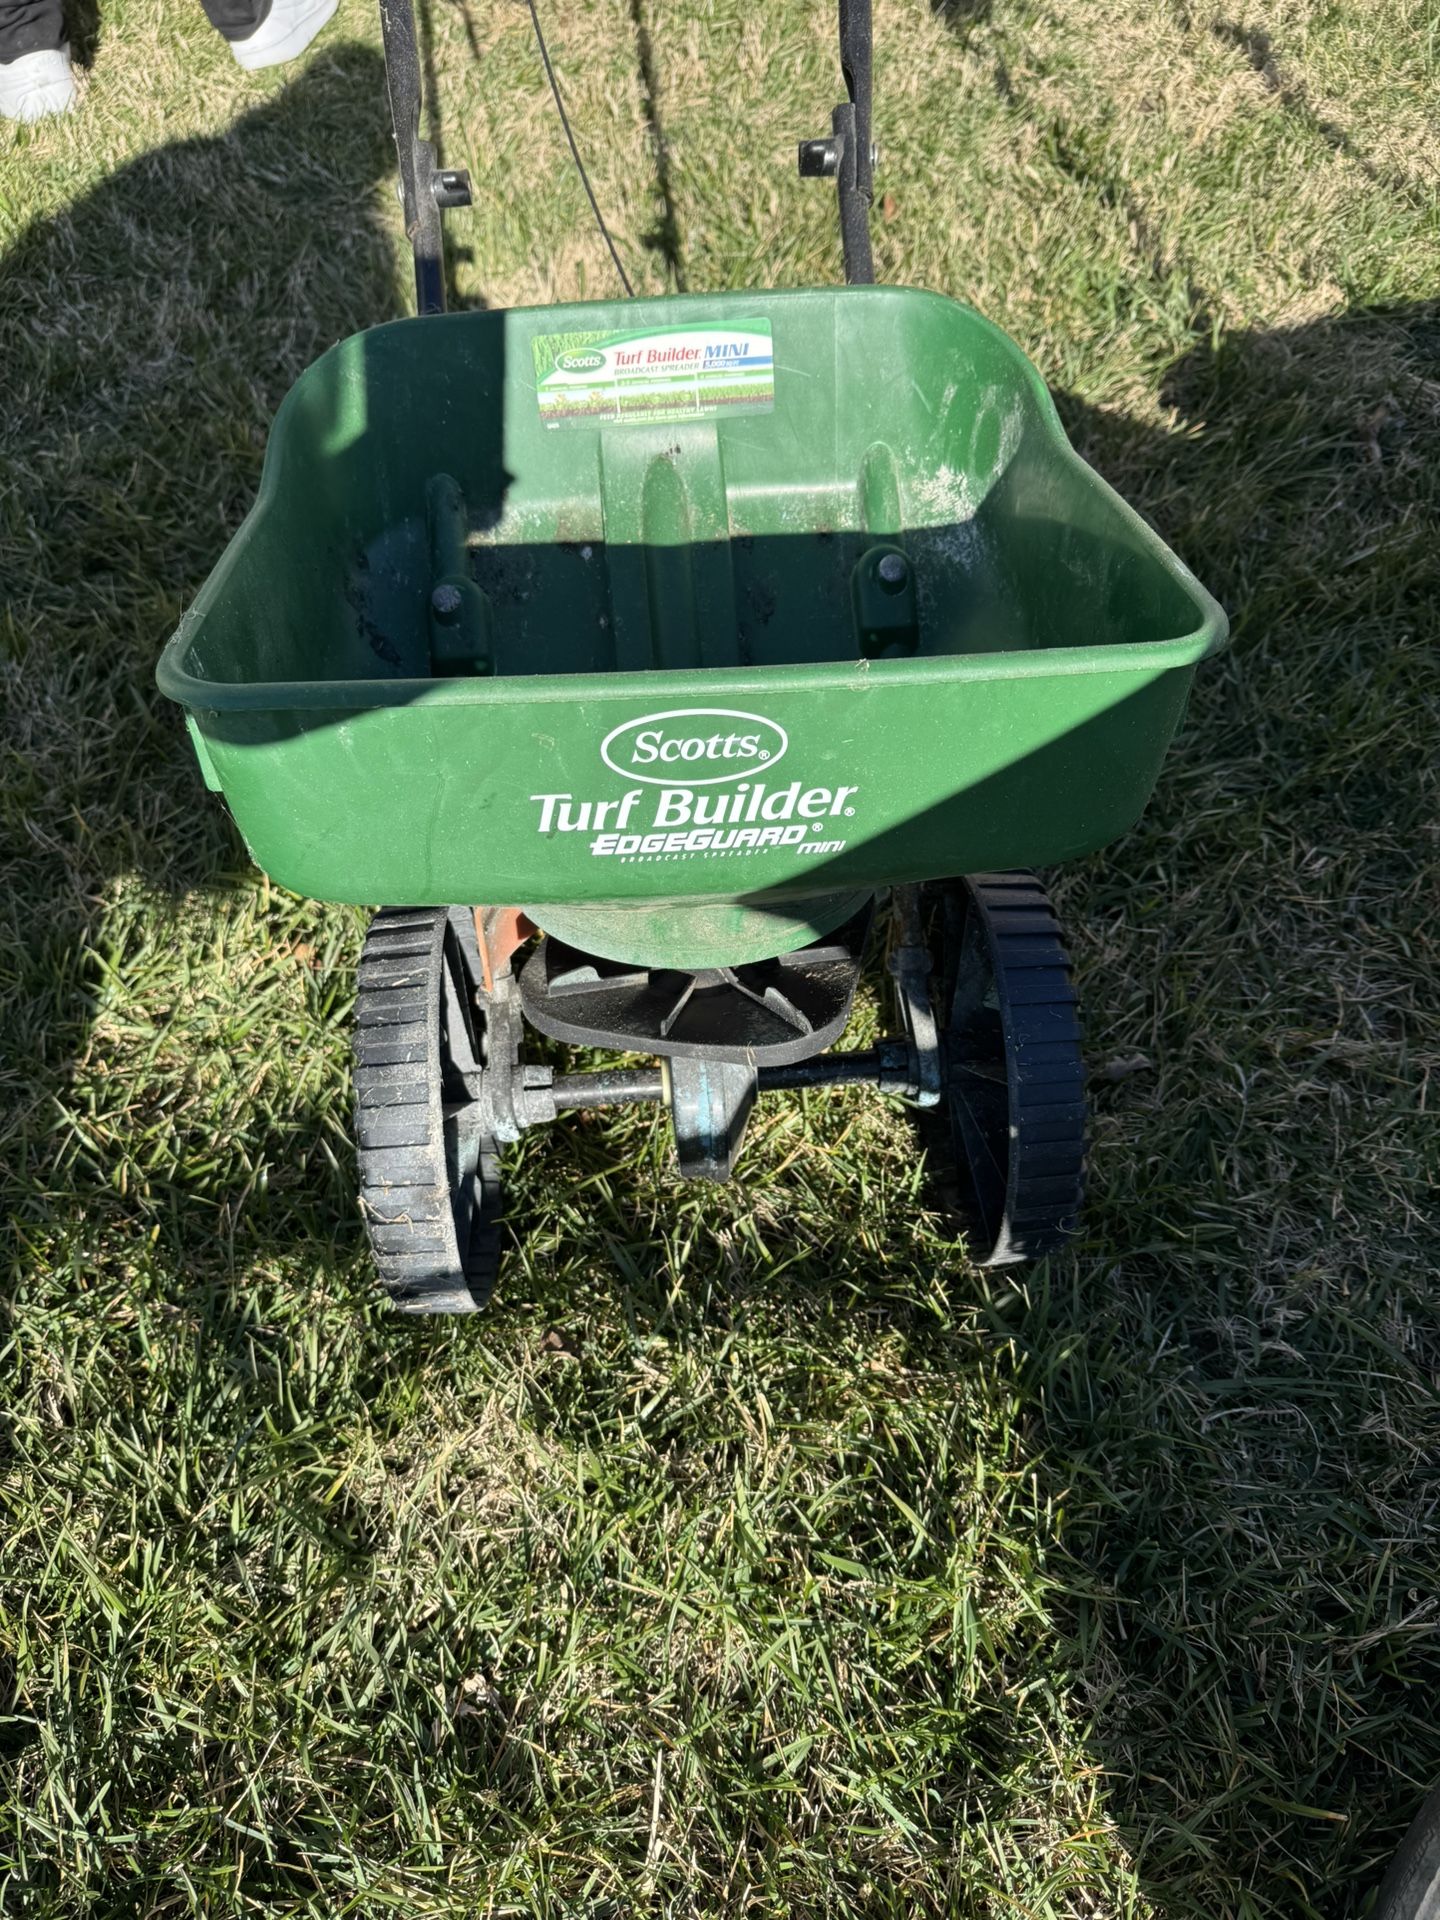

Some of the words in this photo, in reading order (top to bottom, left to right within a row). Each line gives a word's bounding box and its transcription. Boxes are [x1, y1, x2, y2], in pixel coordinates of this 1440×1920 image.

[562, 353, 602, 369] Scotts
[613, 349, 643, 366] Turf
[646, 346, 702, 364] Builder
[704, 342, 750, 359] MINI
[613, 365, 659, 376] BROADCAST
[660, 362, 700, 373] SPREADER
[529, 787, 644, 833] Turf
[620, 852, 696, 864] BROADCAST
[703, 848, 769, 859] SPREADER
